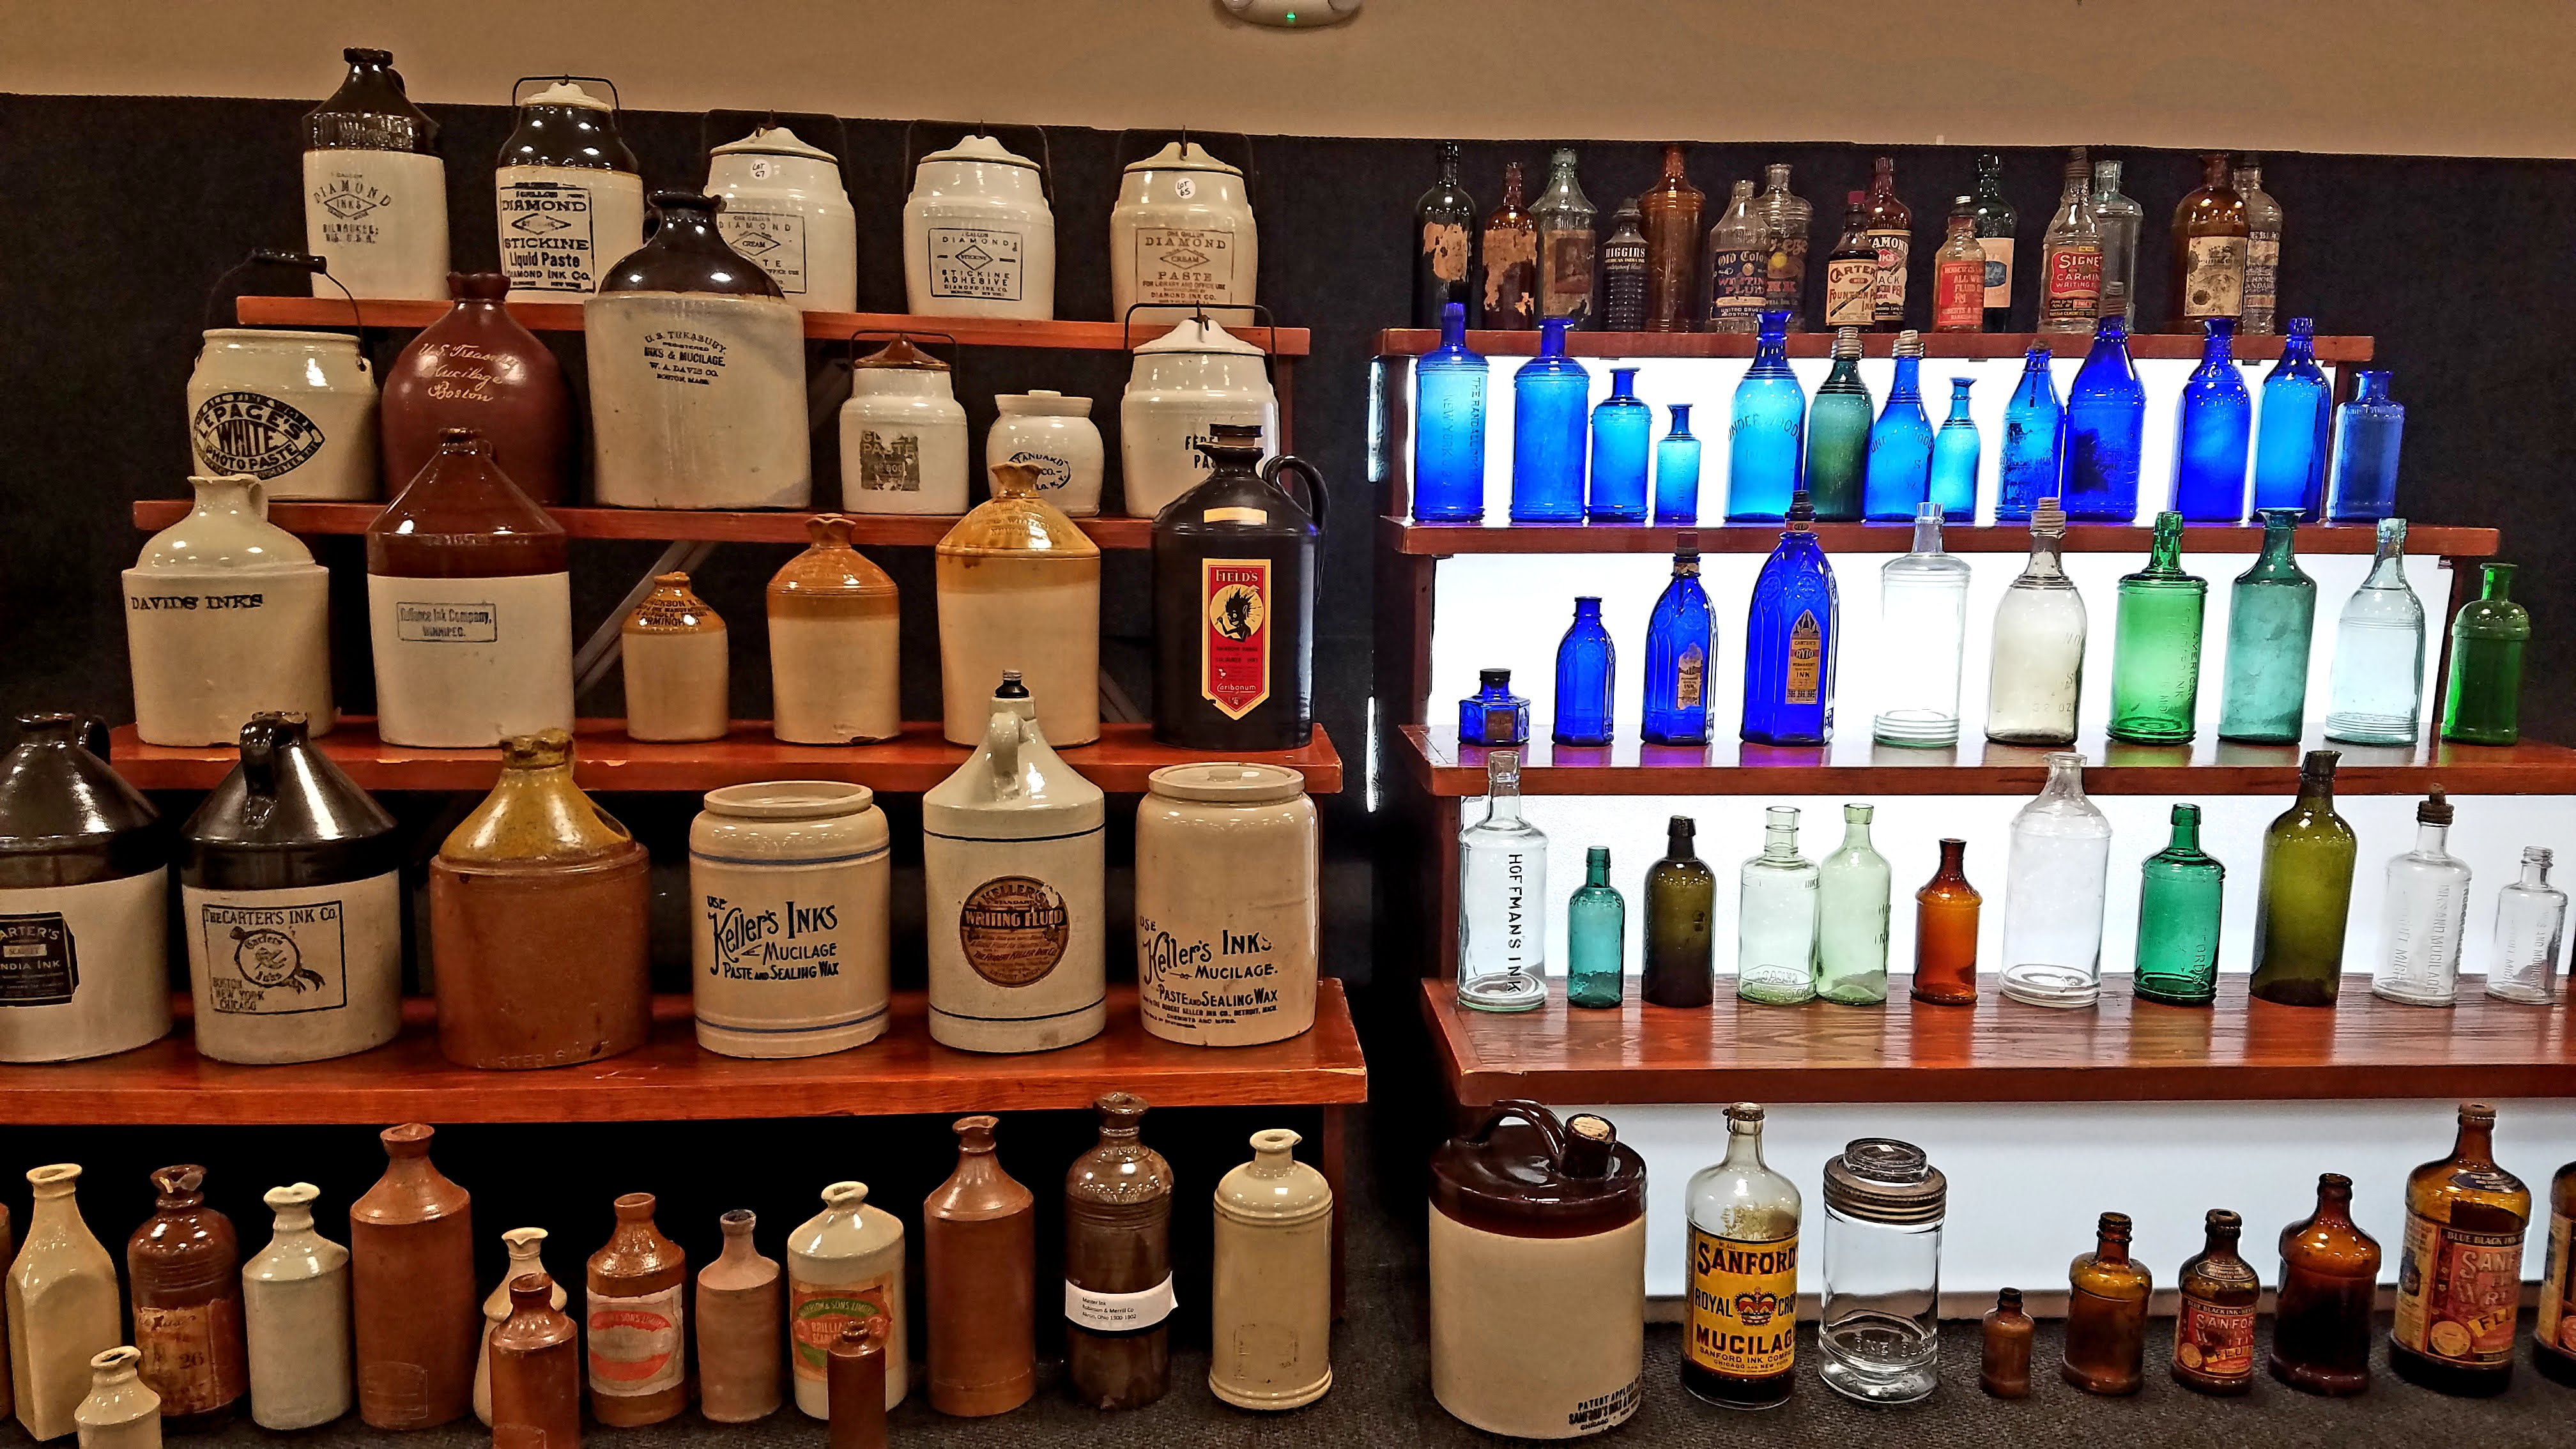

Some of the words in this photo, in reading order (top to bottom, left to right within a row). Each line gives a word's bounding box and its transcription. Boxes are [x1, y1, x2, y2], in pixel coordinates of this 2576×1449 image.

[314, 180, 391, 206] DIAMOND
[502, 200, 586, 211] DIAMOND
[719, 221, 791, 231] DIAMOND
[505, 238, 590, 250] STICKINE
[942, 236, 1009, 246] DIAMOND
[1146, 237, 1226, 249] DIAMOND
[1606, 247, 1645, 257] HIGGINS
[510, 251, 538, 268] Liquid
[542, 252, 579, 268] Paste
[1718, 254, 1736, 266] Old
[548, 270, 567, 279] INK
[942, 270, 1010, 279] STICKINE
[944, 276, 1008, 286] ADHESIVE
[1158, 272, 1212, 282] PASTE
[1878, 275, 1899, 284] ACK
[2057, 273, 2100, 281] CARMIN
[668, 351, 675, 360] &
[428, 381, 494, 402] Boston
[217, 419, 277, 457] WHITE
[206, 445, 246, 470] PHOTO
[249, 443, 296, 470] PASTE
[1012, 452, 1063, 466] TANDARD
[1216, 569, 1258, 582] FIELD'S
[204, 594, 263, 609] INKS
[1795, 648, 1814, 658] RYTO
[1217, 684, 1256, 693] Caribonum
[981, 884, 1046, 904] KELLER'S
[707, 895, 728, 910] USE
[1507, 854, 1525, 949] HOFFMAN'S
[224, 911, 284, 925] CARTER'S
[289, 909, 315, 924] INK
[965, 910, 1021, 926] WRITING
[1025, 909, 1064, 926] FLUID
[1140, 916, 1156, 931] USE
[0, 926, 59, 940] ARTER'S
[707, 907, 779, 976] Keller's
[785, 901, 838, 939] INKS
[763, 942, 838, 965] MUCILAGE
[1142, 931, 1212, 985] Keller's
[38, 960, 61, 969] INK
[723, 962, 753, 980] PASTE
[769, 964, 817, 980] SEALING
[818, 960, 839, 977] WAX
[1507, 957, 1521, 992] INK
[213, 977, 242, 990] BOSTON
[239, 990, 264, 1000] YORK
[1157, 983, 1188, 1004] PASTE
[1188, 997, 1202, 1006] AND
[1201, 990, 1254, 1007] SEALING
[1254, 987, 1278, 1004] WAX
[220, 998, 256, 1011] CHICAGO
[2447, 1232, 2471, 1243] BLUE
[2474, 1236, 2501, 1245] BLACK
[831, 1301, 849, 1310] SONS
[1695, 1287, 1733, 1318] ROYAL
[2203, 1306, 2225, 1315] BLACK
[2196, 1314, 2254, 1330] SANFOR
[1696, 1323, 1793, 1355] MUCILAG
[1699, 1347, 1742, 1362] SANFORD
[1713, 1360, 1745, 1368] CHICAGO
[1578, 1395, 1609, 1411] PATENT
[1580, 1418, 1609, 1430] CHICAGO
